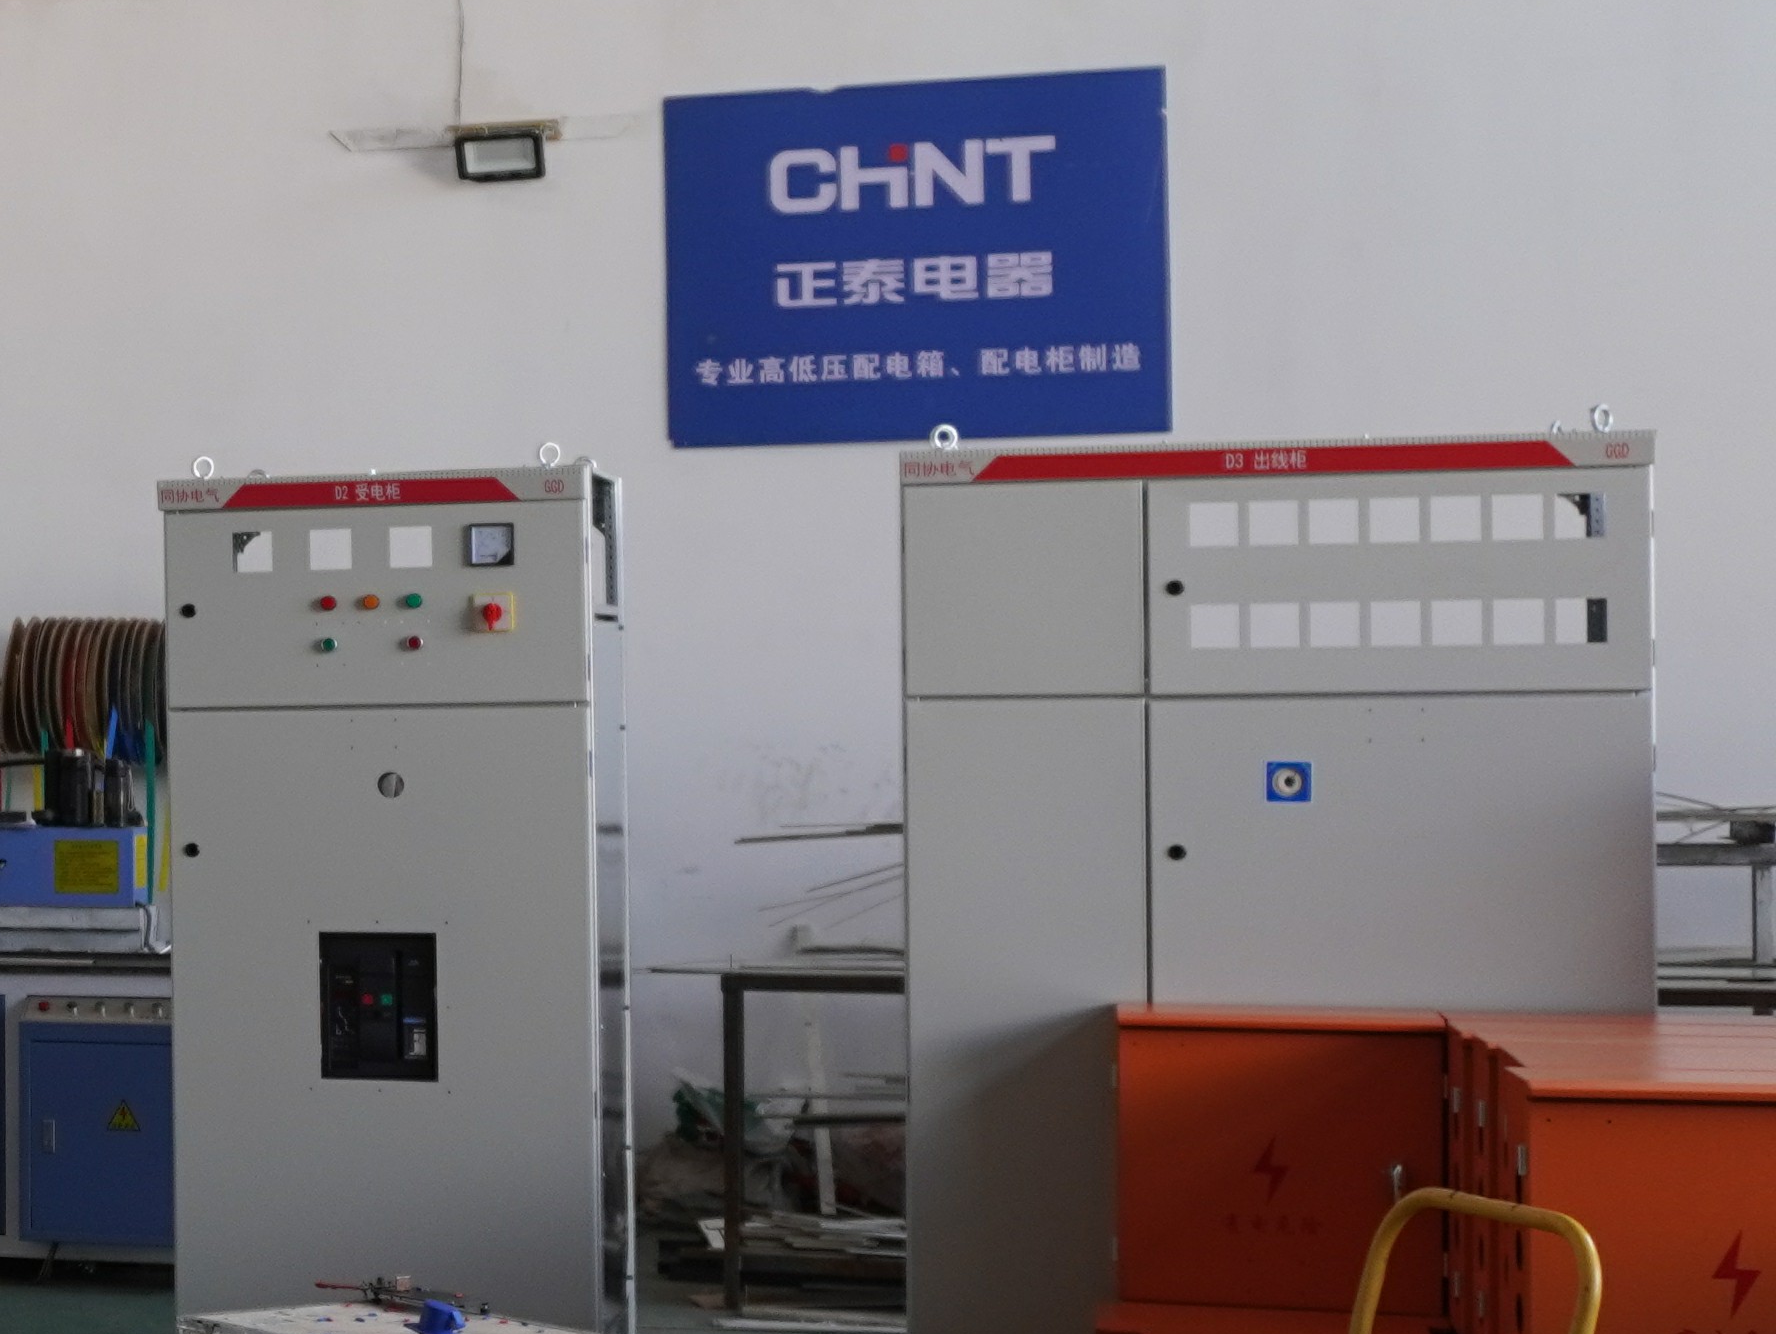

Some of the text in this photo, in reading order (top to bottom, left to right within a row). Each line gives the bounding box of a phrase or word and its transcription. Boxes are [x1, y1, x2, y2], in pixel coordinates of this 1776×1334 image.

[774, 251, 1054, 308] 正泰电器
[1225, 452, 1246, 469] D3
[1253, 449, 1307, 470] 出线柜
[1604, 442, 1632, 460] GGD
[335, 485, 348, 501] D2
[355, 482, 401, 502] 受电柜
[544, 479, 565, 496] GGD
